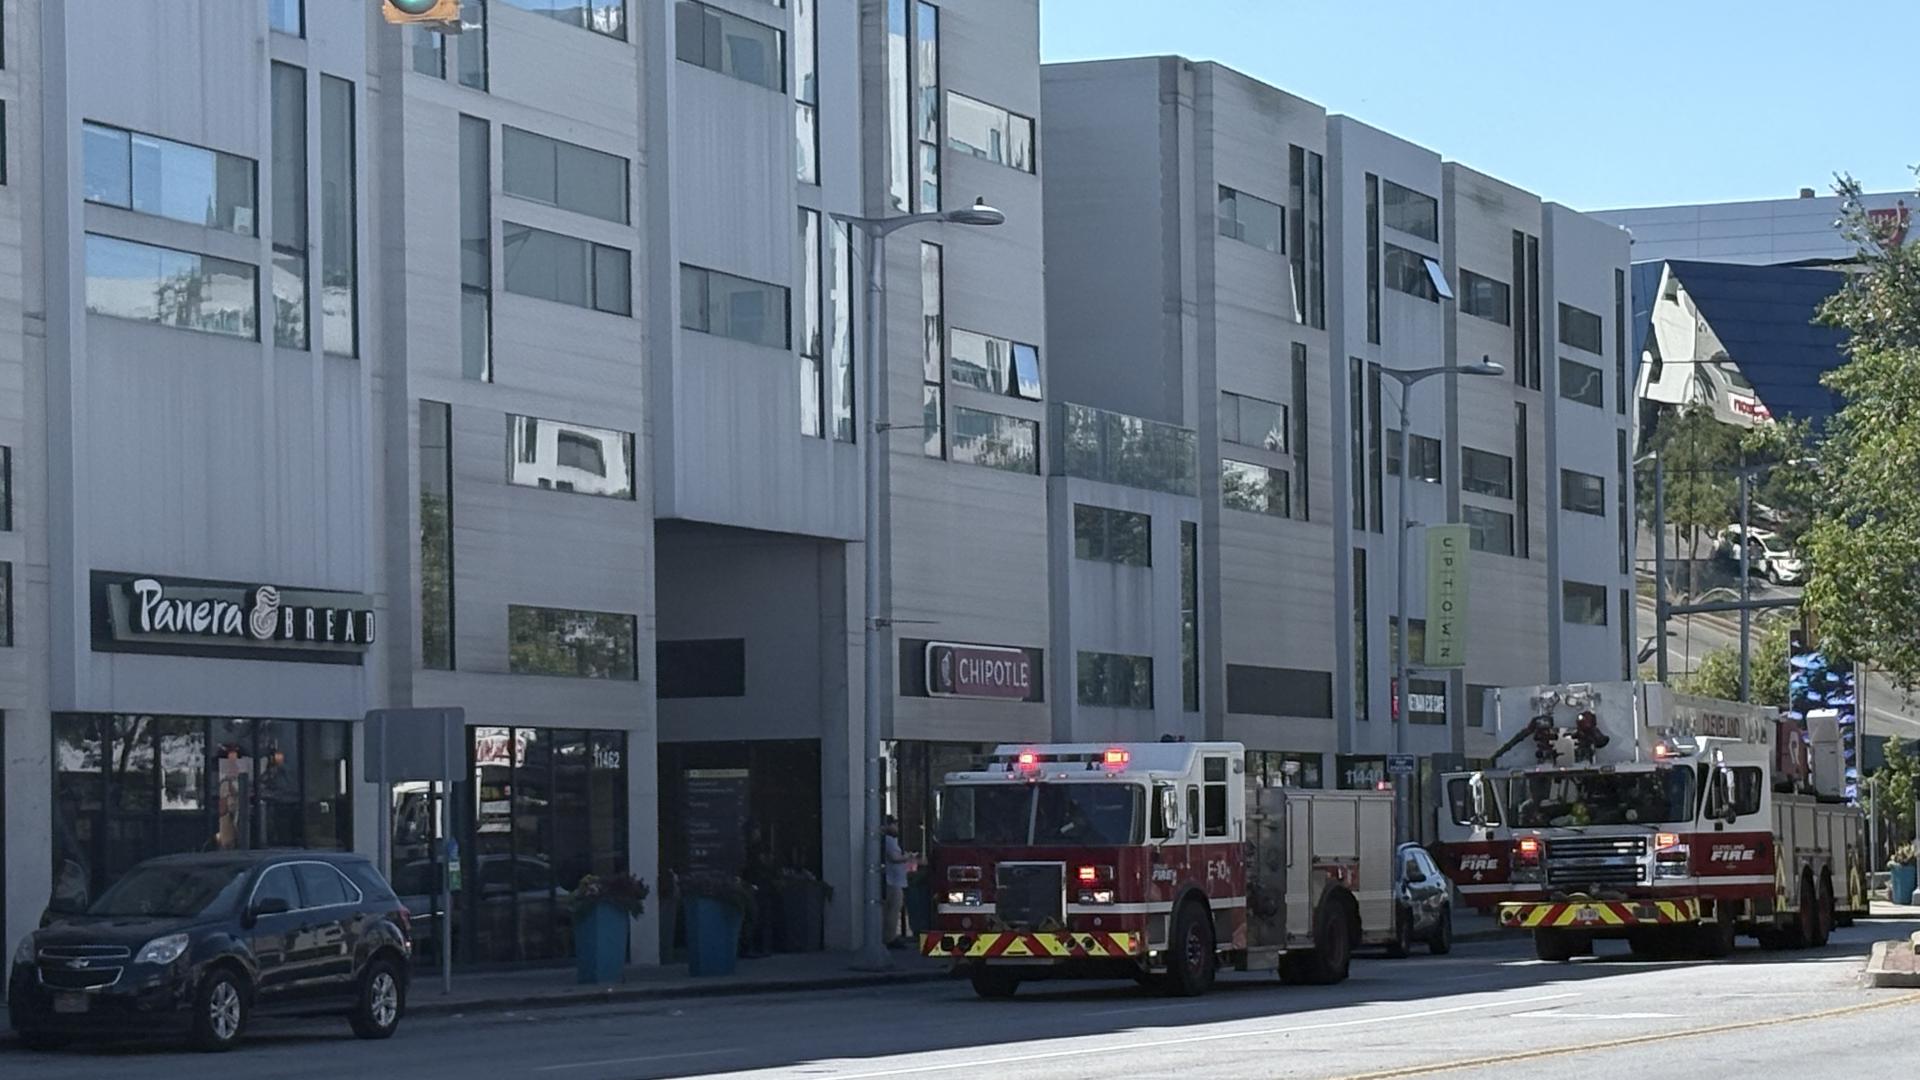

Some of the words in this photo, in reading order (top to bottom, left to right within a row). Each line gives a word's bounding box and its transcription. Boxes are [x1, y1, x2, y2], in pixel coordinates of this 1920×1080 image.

[133, 578, 244, 635] Panera
[284, 606, 376, 644] BREAD
[1440, 537, 1454, 658] UPTOWN
[959, 657, 1029, 688] CHIPOTLE
[1459, 858, 1499, 871] FIRE
[1710, 849, 1756, 862] FIRE
